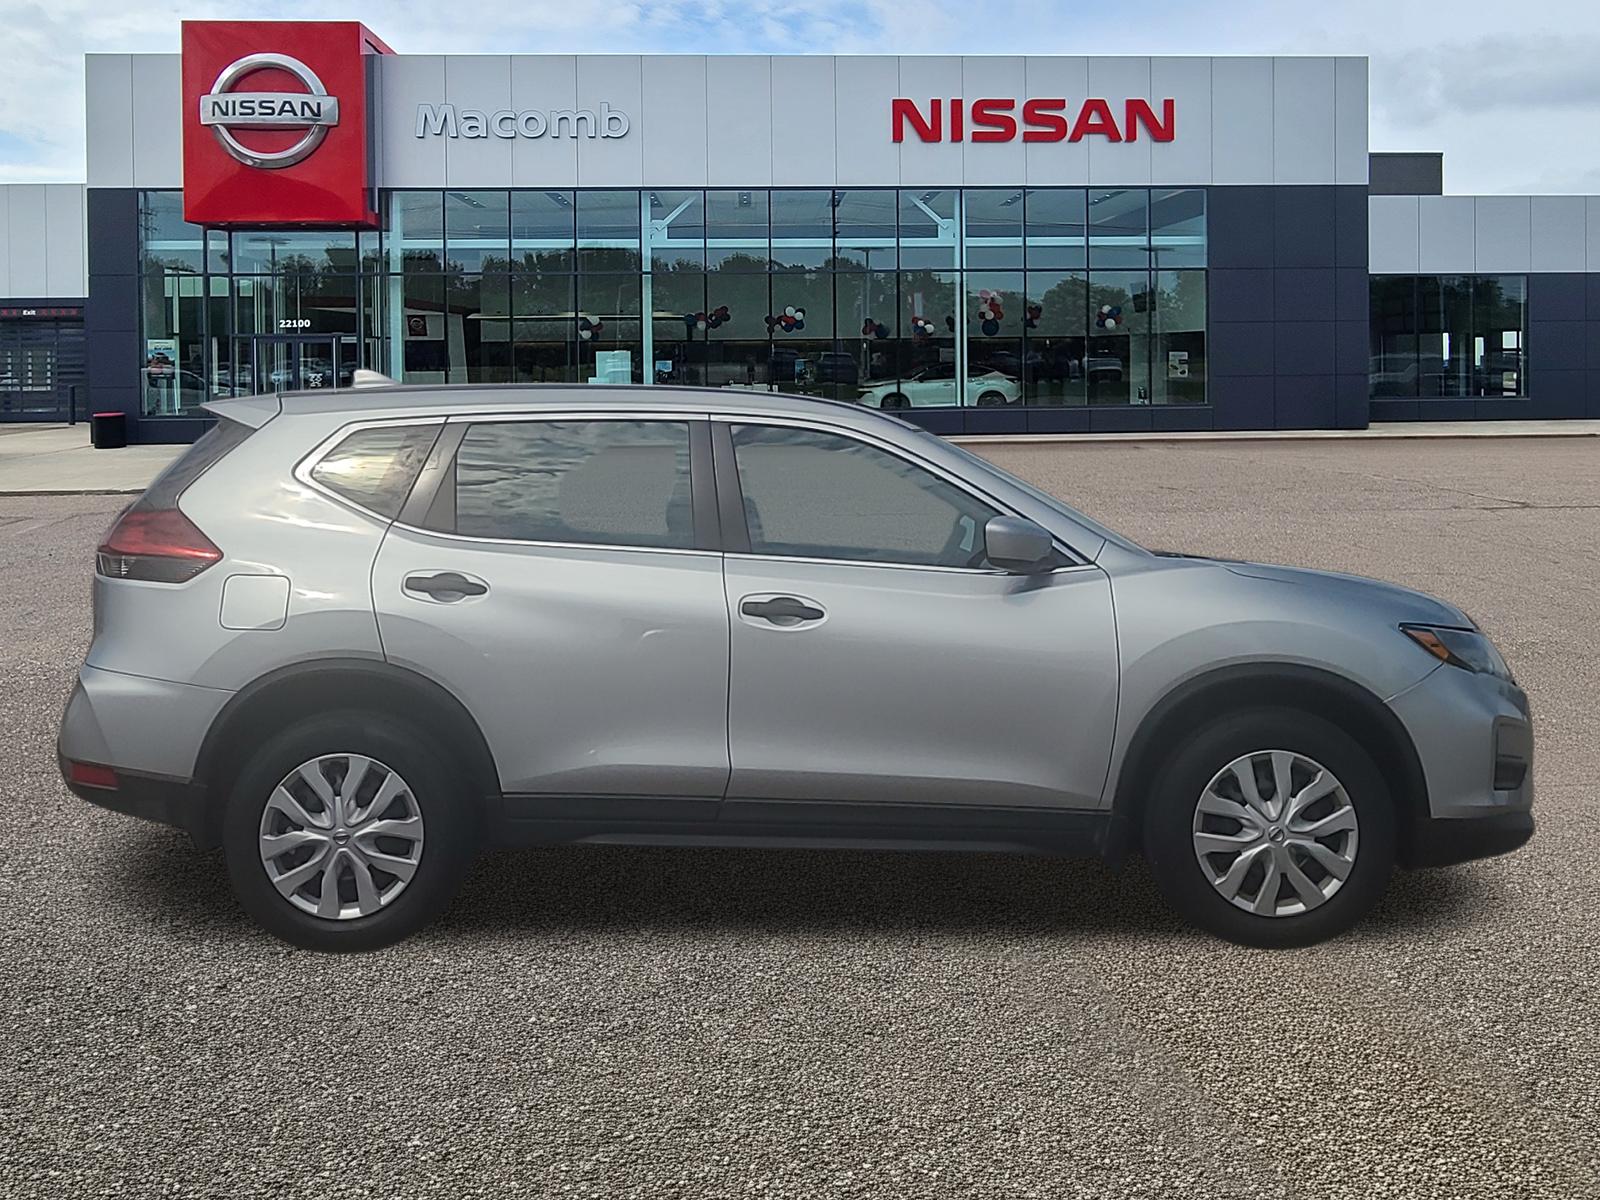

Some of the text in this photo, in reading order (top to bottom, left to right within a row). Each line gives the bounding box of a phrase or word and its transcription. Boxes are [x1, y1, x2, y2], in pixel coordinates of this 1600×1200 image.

[211, 100, 322, 118] NISSAN
[415, 101, 630, 139] Macomb
[892, 98, 1175, 143] NISSAN
[279, 319, 311, 328] 22100
